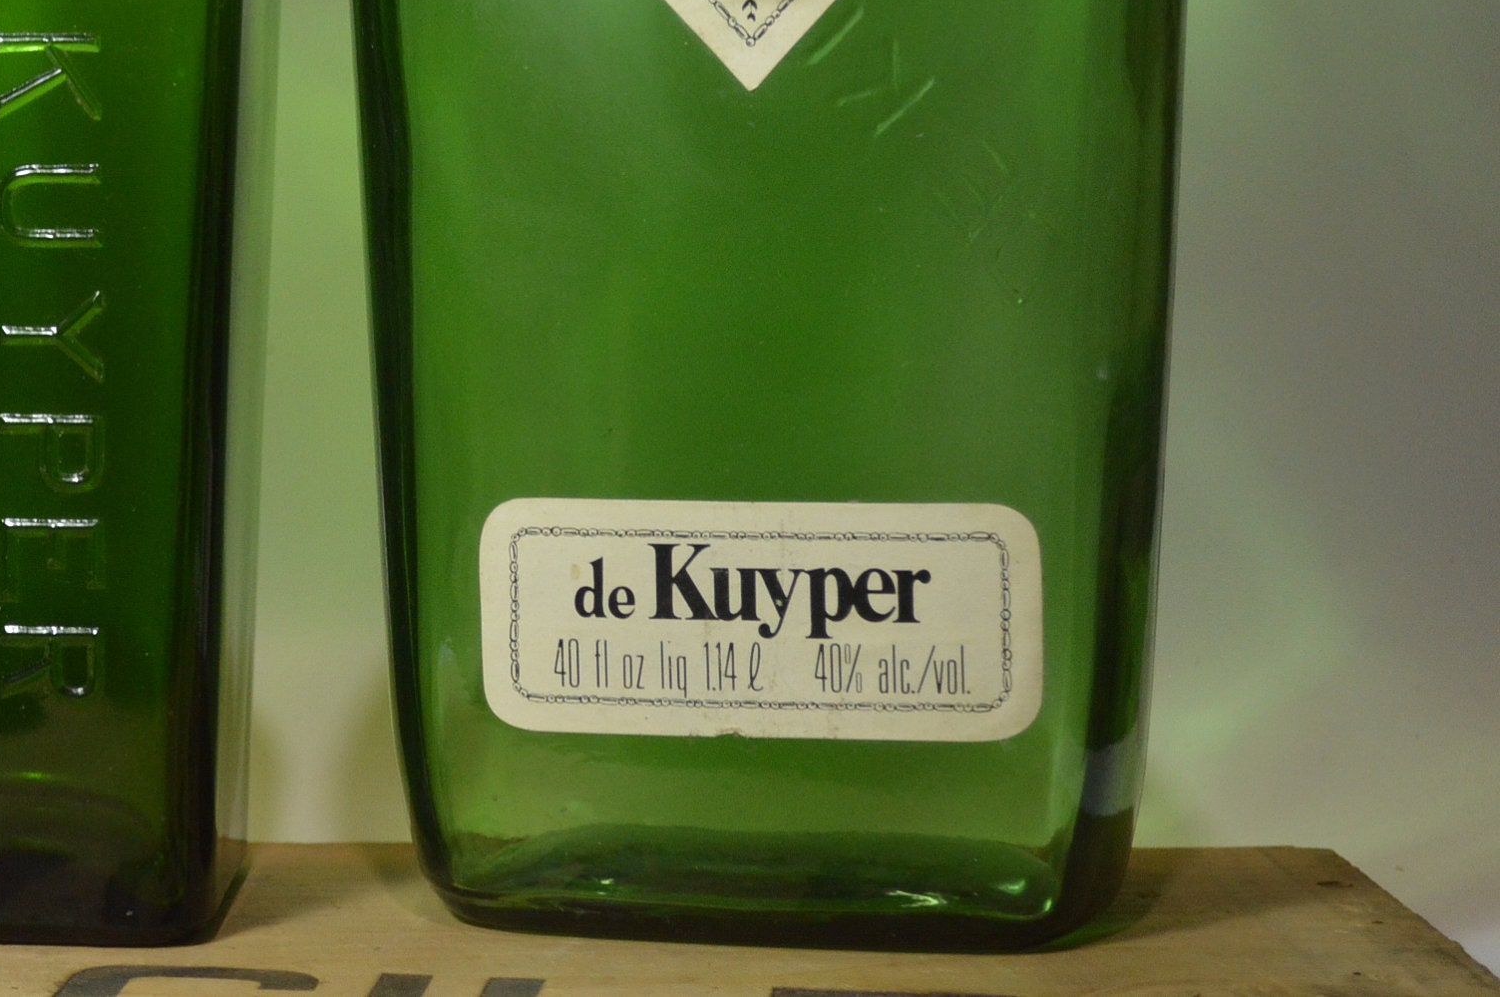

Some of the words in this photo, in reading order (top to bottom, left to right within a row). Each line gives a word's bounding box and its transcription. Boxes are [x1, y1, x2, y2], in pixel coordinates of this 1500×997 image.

[573, 556, 637, 620] de
[646, 542, 932, 640] Kuyper
[554, 637, 581, 689] 40
[594, 638, 609, 689] fl
[622, 653, 645, 690] oz
[659, 639, 688, 699] liq
[703, 640, 738, 691] 1.14
[814, 642, 863, 694] 40%
[878, 643, 972, 695] alc./vol.
